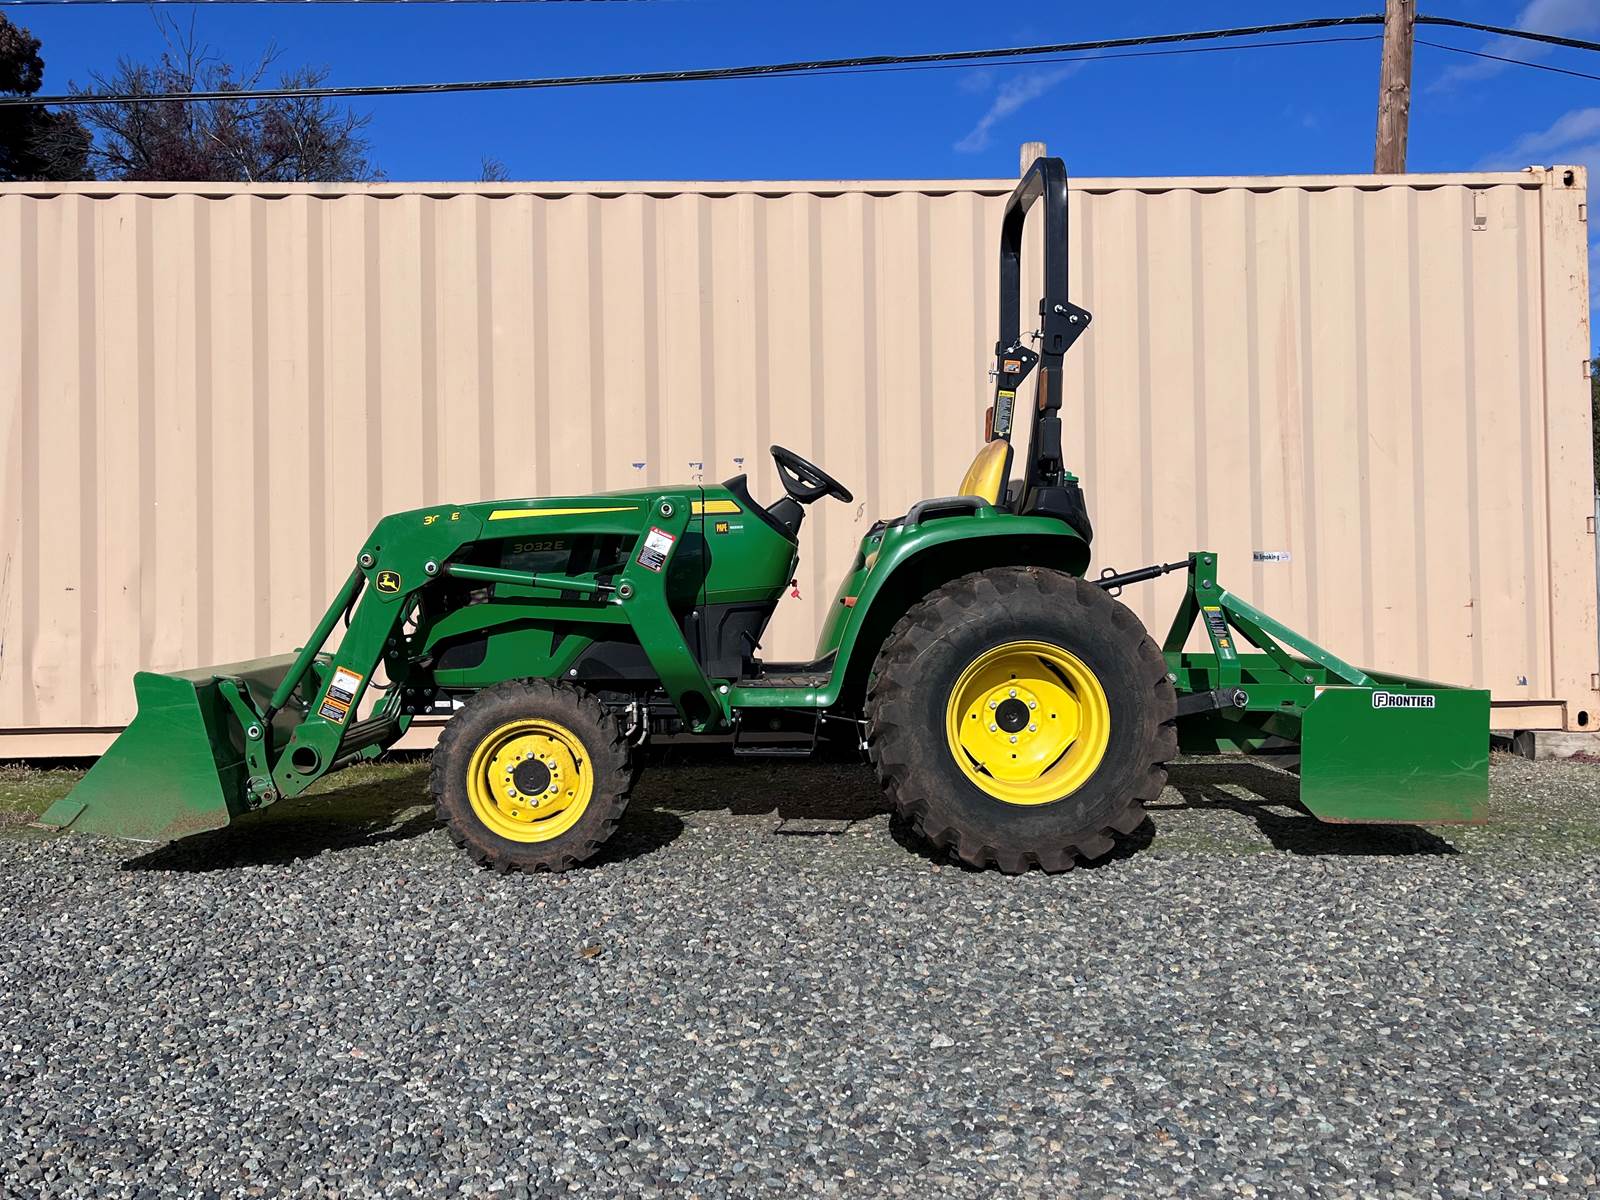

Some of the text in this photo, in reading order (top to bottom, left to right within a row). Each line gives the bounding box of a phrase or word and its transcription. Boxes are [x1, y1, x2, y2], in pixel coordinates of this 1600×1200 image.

[513, 541, 565, 553] 3032E
[1260, 553, 1280, 561] Smoking
[1374, 692, 1434, 707] FRONTIER
